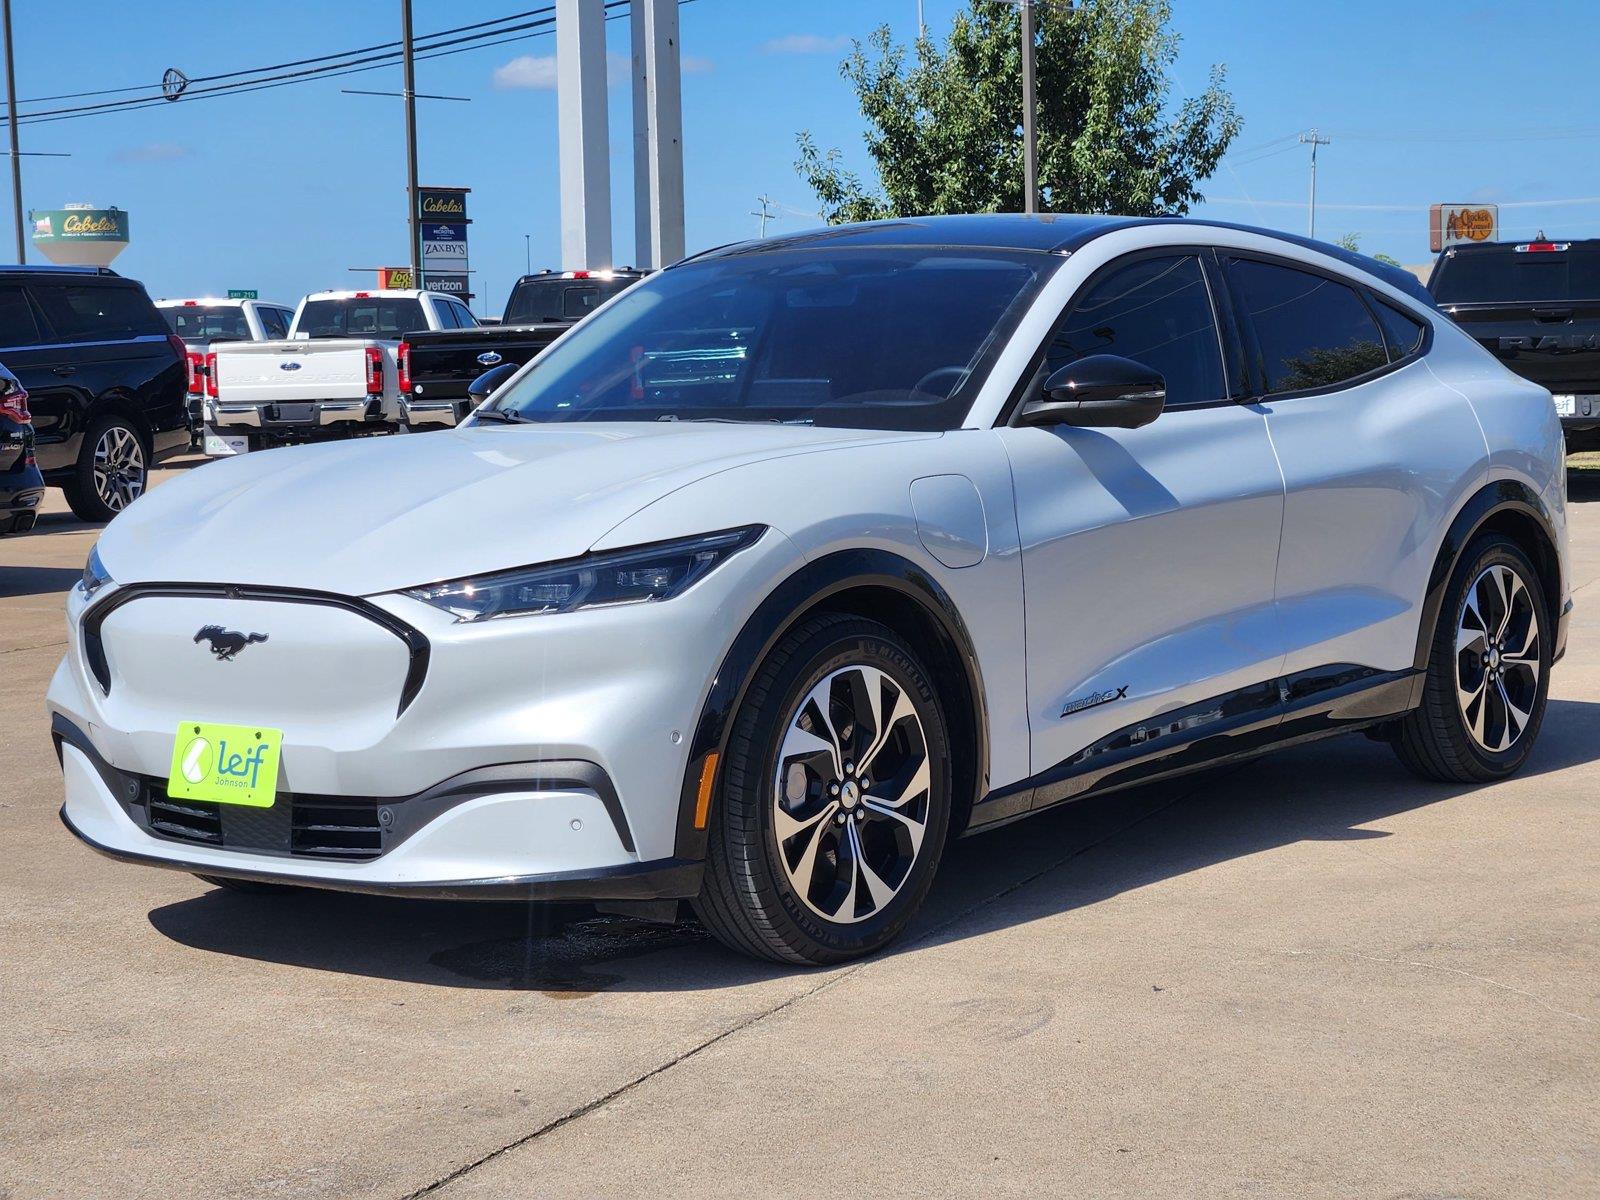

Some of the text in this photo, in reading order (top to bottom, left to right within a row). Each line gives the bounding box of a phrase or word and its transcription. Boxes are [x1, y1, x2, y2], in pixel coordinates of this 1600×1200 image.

[423, 198, 463, 212] Cabela's
[425, 244, 465, 255] ZAXBY'S
[388, 271, 413, 288] Loga
[426, 280, 462, 291] verizon
[242, 291, 255, 299] 219
[879, 645, 932, 703] MICHELIN
[218, 741, 269, 789] leif
[215, 777, 248, 788] Johnson
